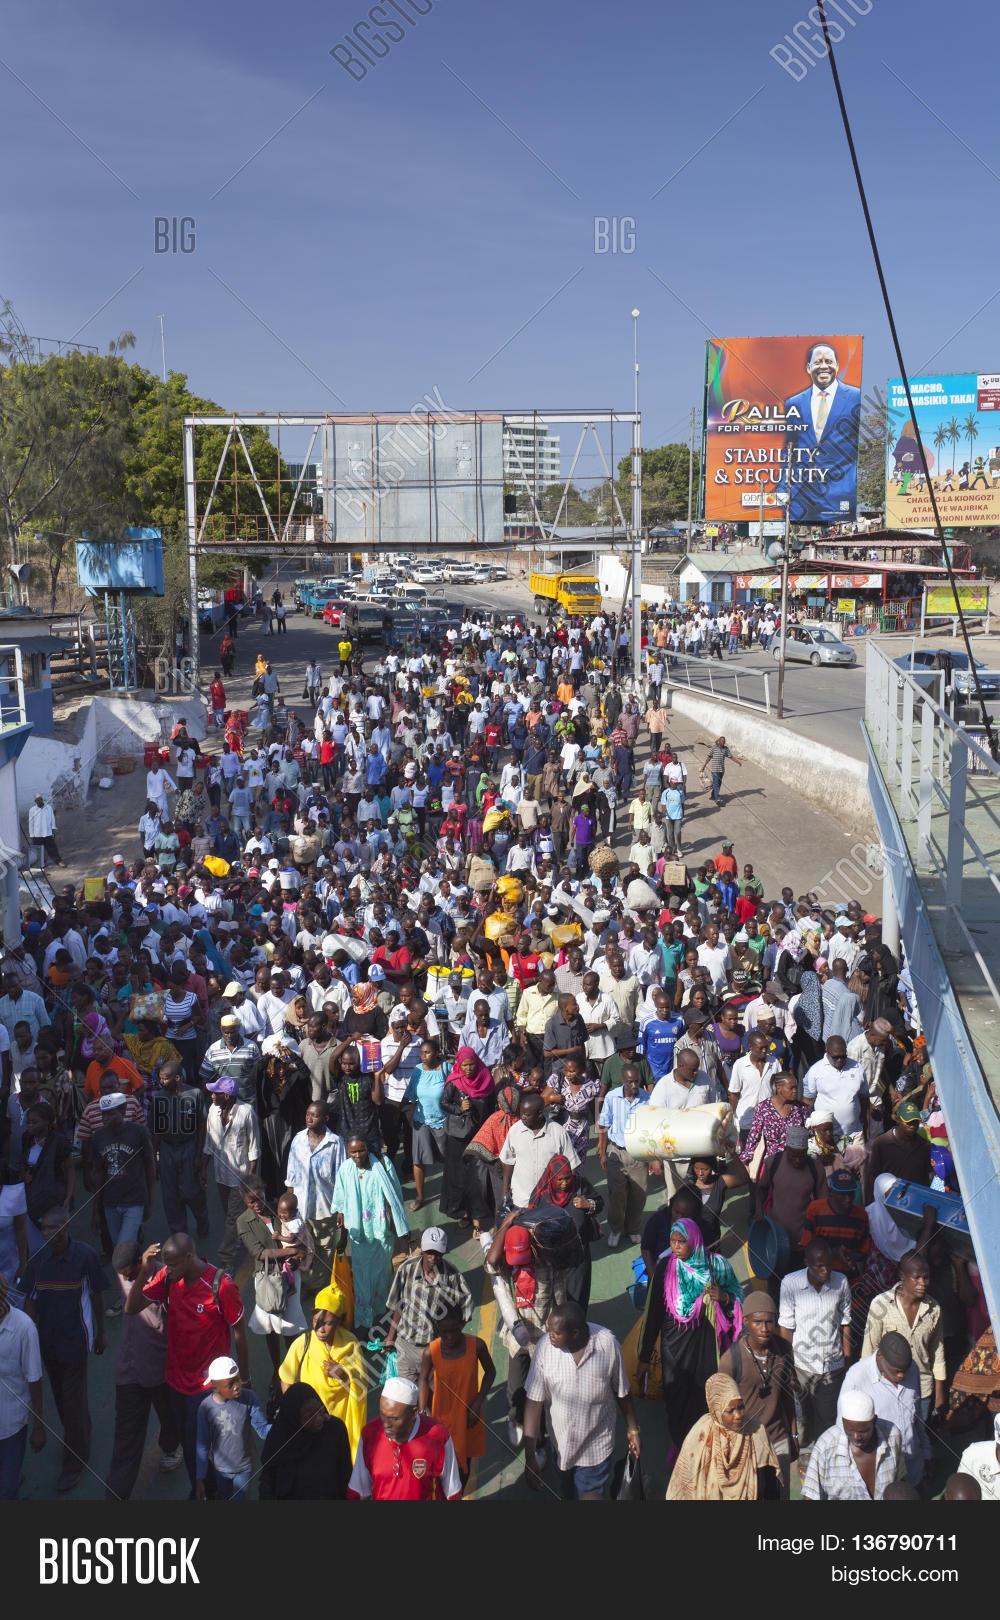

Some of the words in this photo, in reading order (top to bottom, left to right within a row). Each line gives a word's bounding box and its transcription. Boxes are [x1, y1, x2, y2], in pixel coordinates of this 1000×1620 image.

[910, 383, 945, 394] MACHO,
[911, 395, 948, 406] MASIKIO
[949, 394, 976, 404] TAKA!
[721, 398, 801, 424] RAILA
[744, 424, 809, 432] PRESIDENT
[714, 468, 730, 484] &
[734, 468, 830, 484] SECURITY
[906, 496, 941, 504] CHAGO
[954, 494, 995, 502] KIONGOZI
[949, 504, 989, 512] WAJIBIKA
[900, 516, 920, 524] LIKO
[964, 514, 1000, 522] MWAKO!
